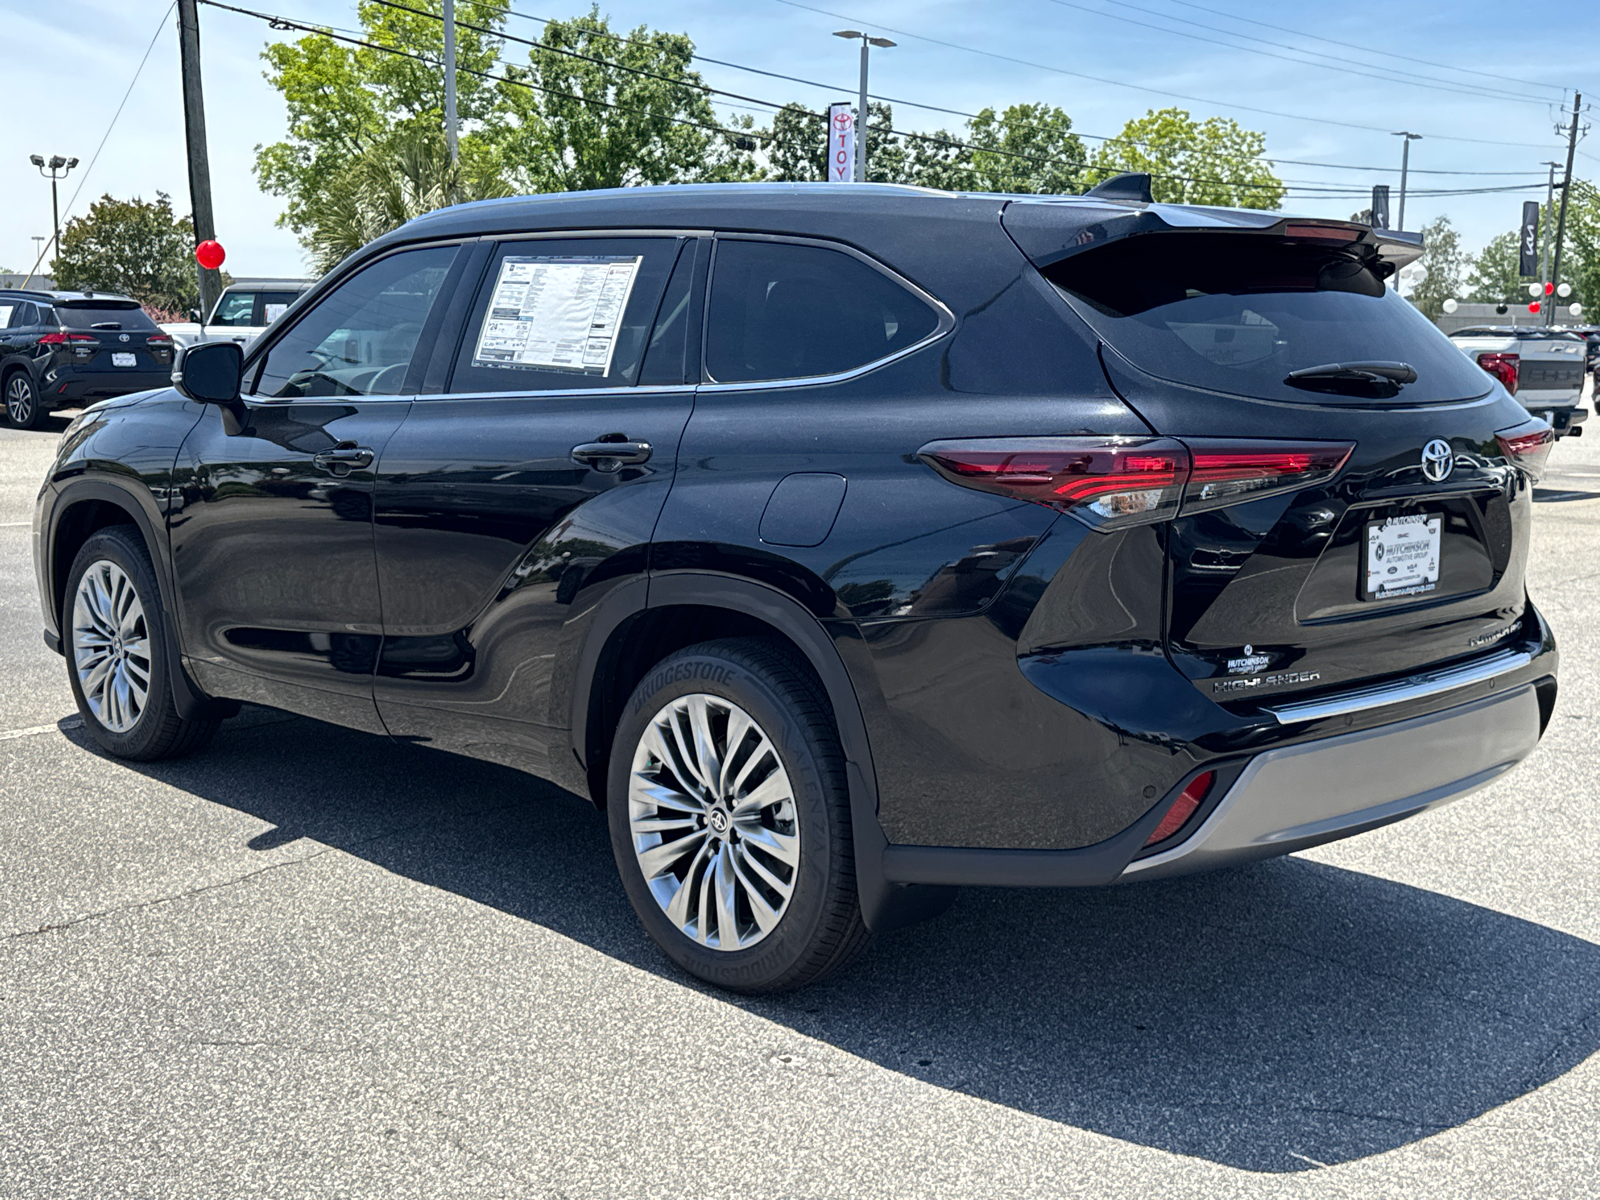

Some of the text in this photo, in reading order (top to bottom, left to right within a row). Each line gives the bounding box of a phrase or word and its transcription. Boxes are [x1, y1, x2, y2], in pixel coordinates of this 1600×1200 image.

[1386, 541, 1430, 556] HUTCHINSON
[1228, 656, 1269, 668] HUTCHINSON
[633, 660, 736, 713] BRIDGESTONE
[1213, 669, 1320, 692] HIGHLANDER
